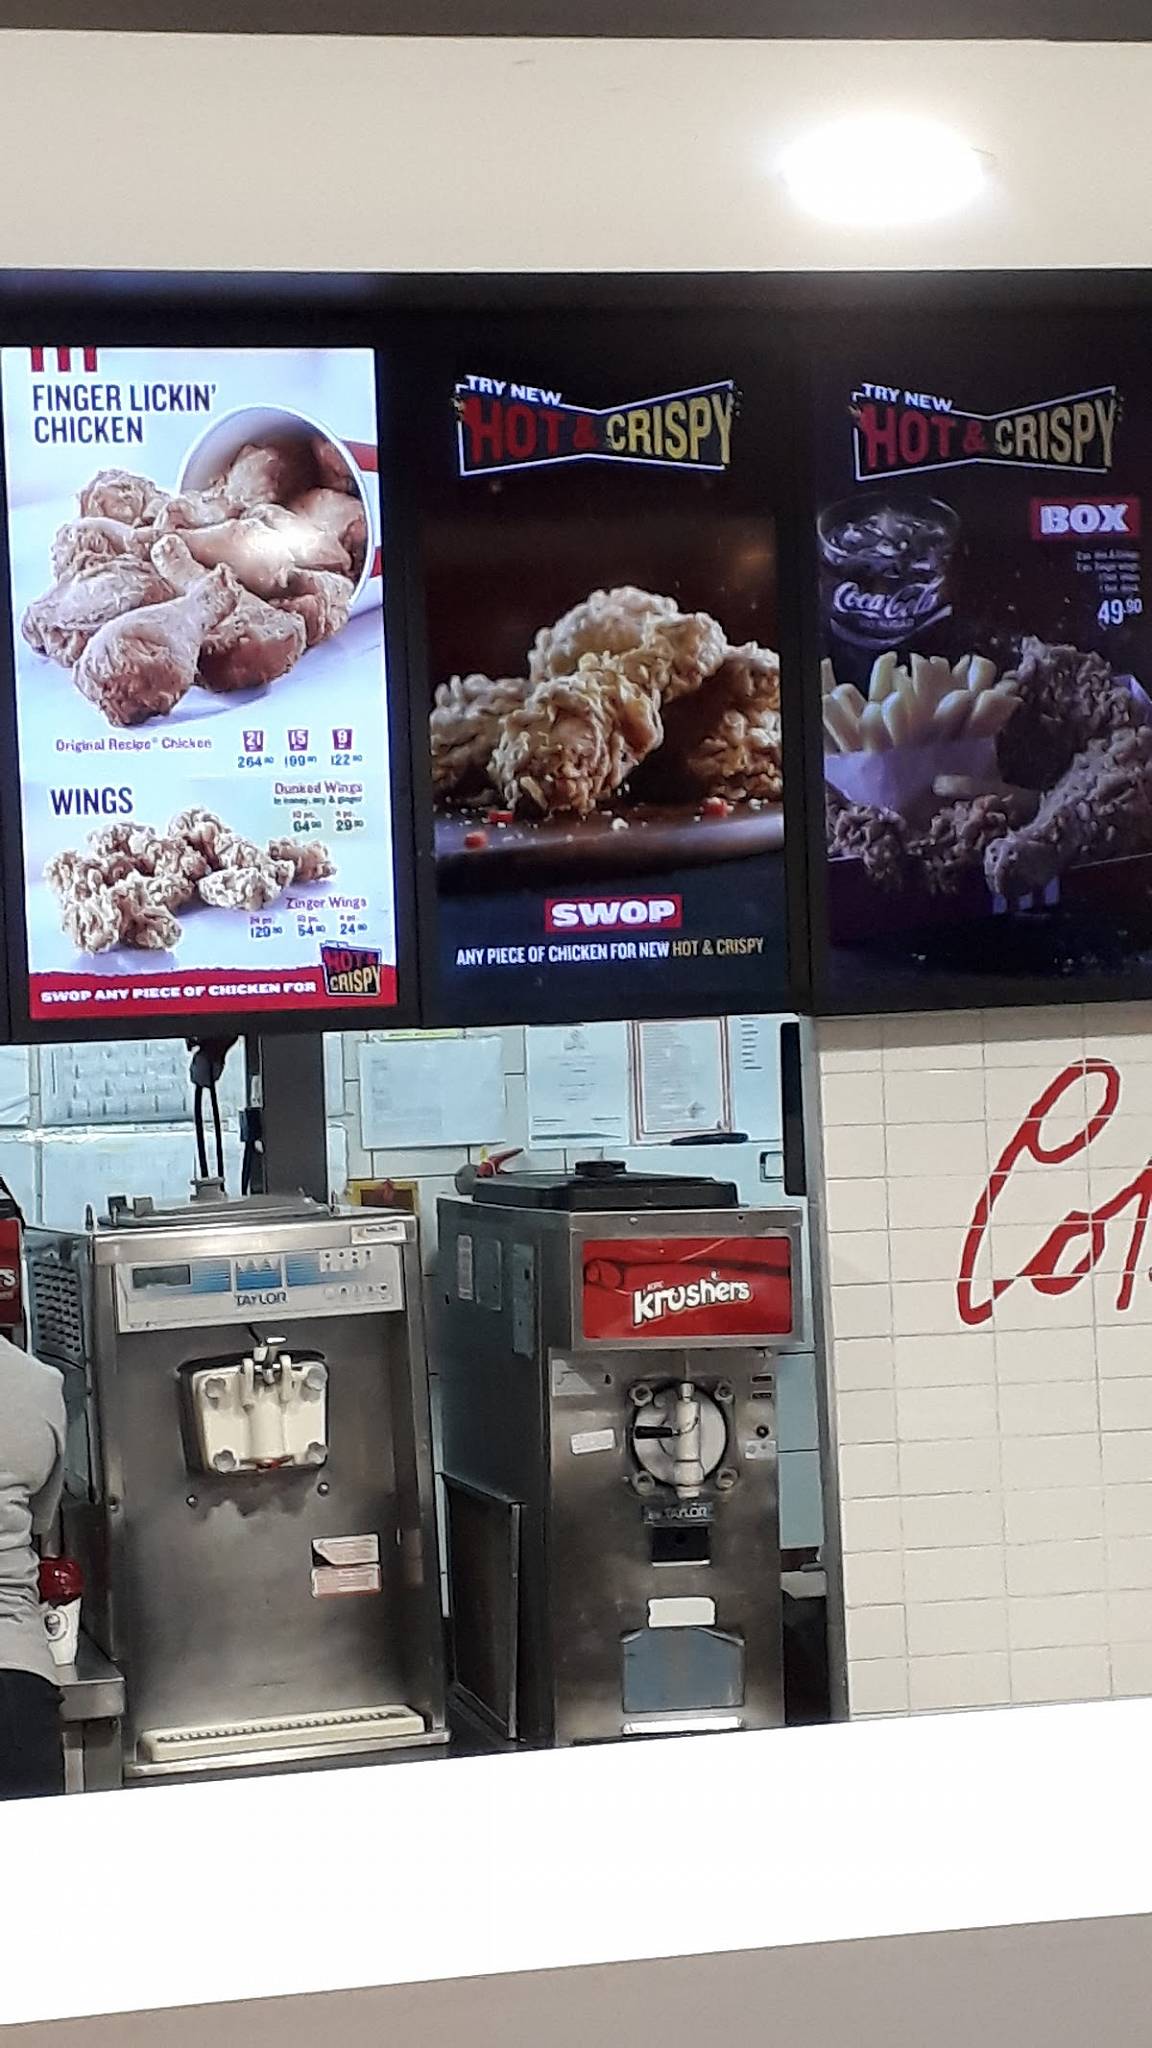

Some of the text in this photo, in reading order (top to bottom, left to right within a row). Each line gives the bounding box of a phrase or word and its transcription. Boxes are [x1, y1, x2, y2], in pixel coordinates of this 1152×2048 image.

[33, 384, 122, 412] FINGER
[465, 374, 562, 406] TRY NEW
[861, 382, 953, 412] TRY NEW
[34, 416, 144, 443] CHICKEN
[462, 391, 735, 465] HOT & CRISPY
[860, 398, 1118, 468] HOT & CRISPY
[1040, 504, 1130, 533] BOX
[55, 739, 105, 752] Original
[161, 737, 213, 749] Chicken
[245, 732, 262, 747] 21
[290, 731, 307, 746] 15
[50, 786, 134, 815] WINGS
[324, 781, 362, 794] Wings
[286, 896, 367, 911] Zinger Wings
[551, 900, 676, 928] SWOP
[456, 937, 764, 965] ANY PIECE OF CHICKEN FOR NEW HOT & CRISPY
[41, 982, 317, 1003] SWOP ANY PIECE OF CHICKEN FOR
[329, 966, 380, 994] CRISPY
[236, 1292, 288, 1307] TAYLOR
[664, 1506, 708, 1519] TAYLOR
